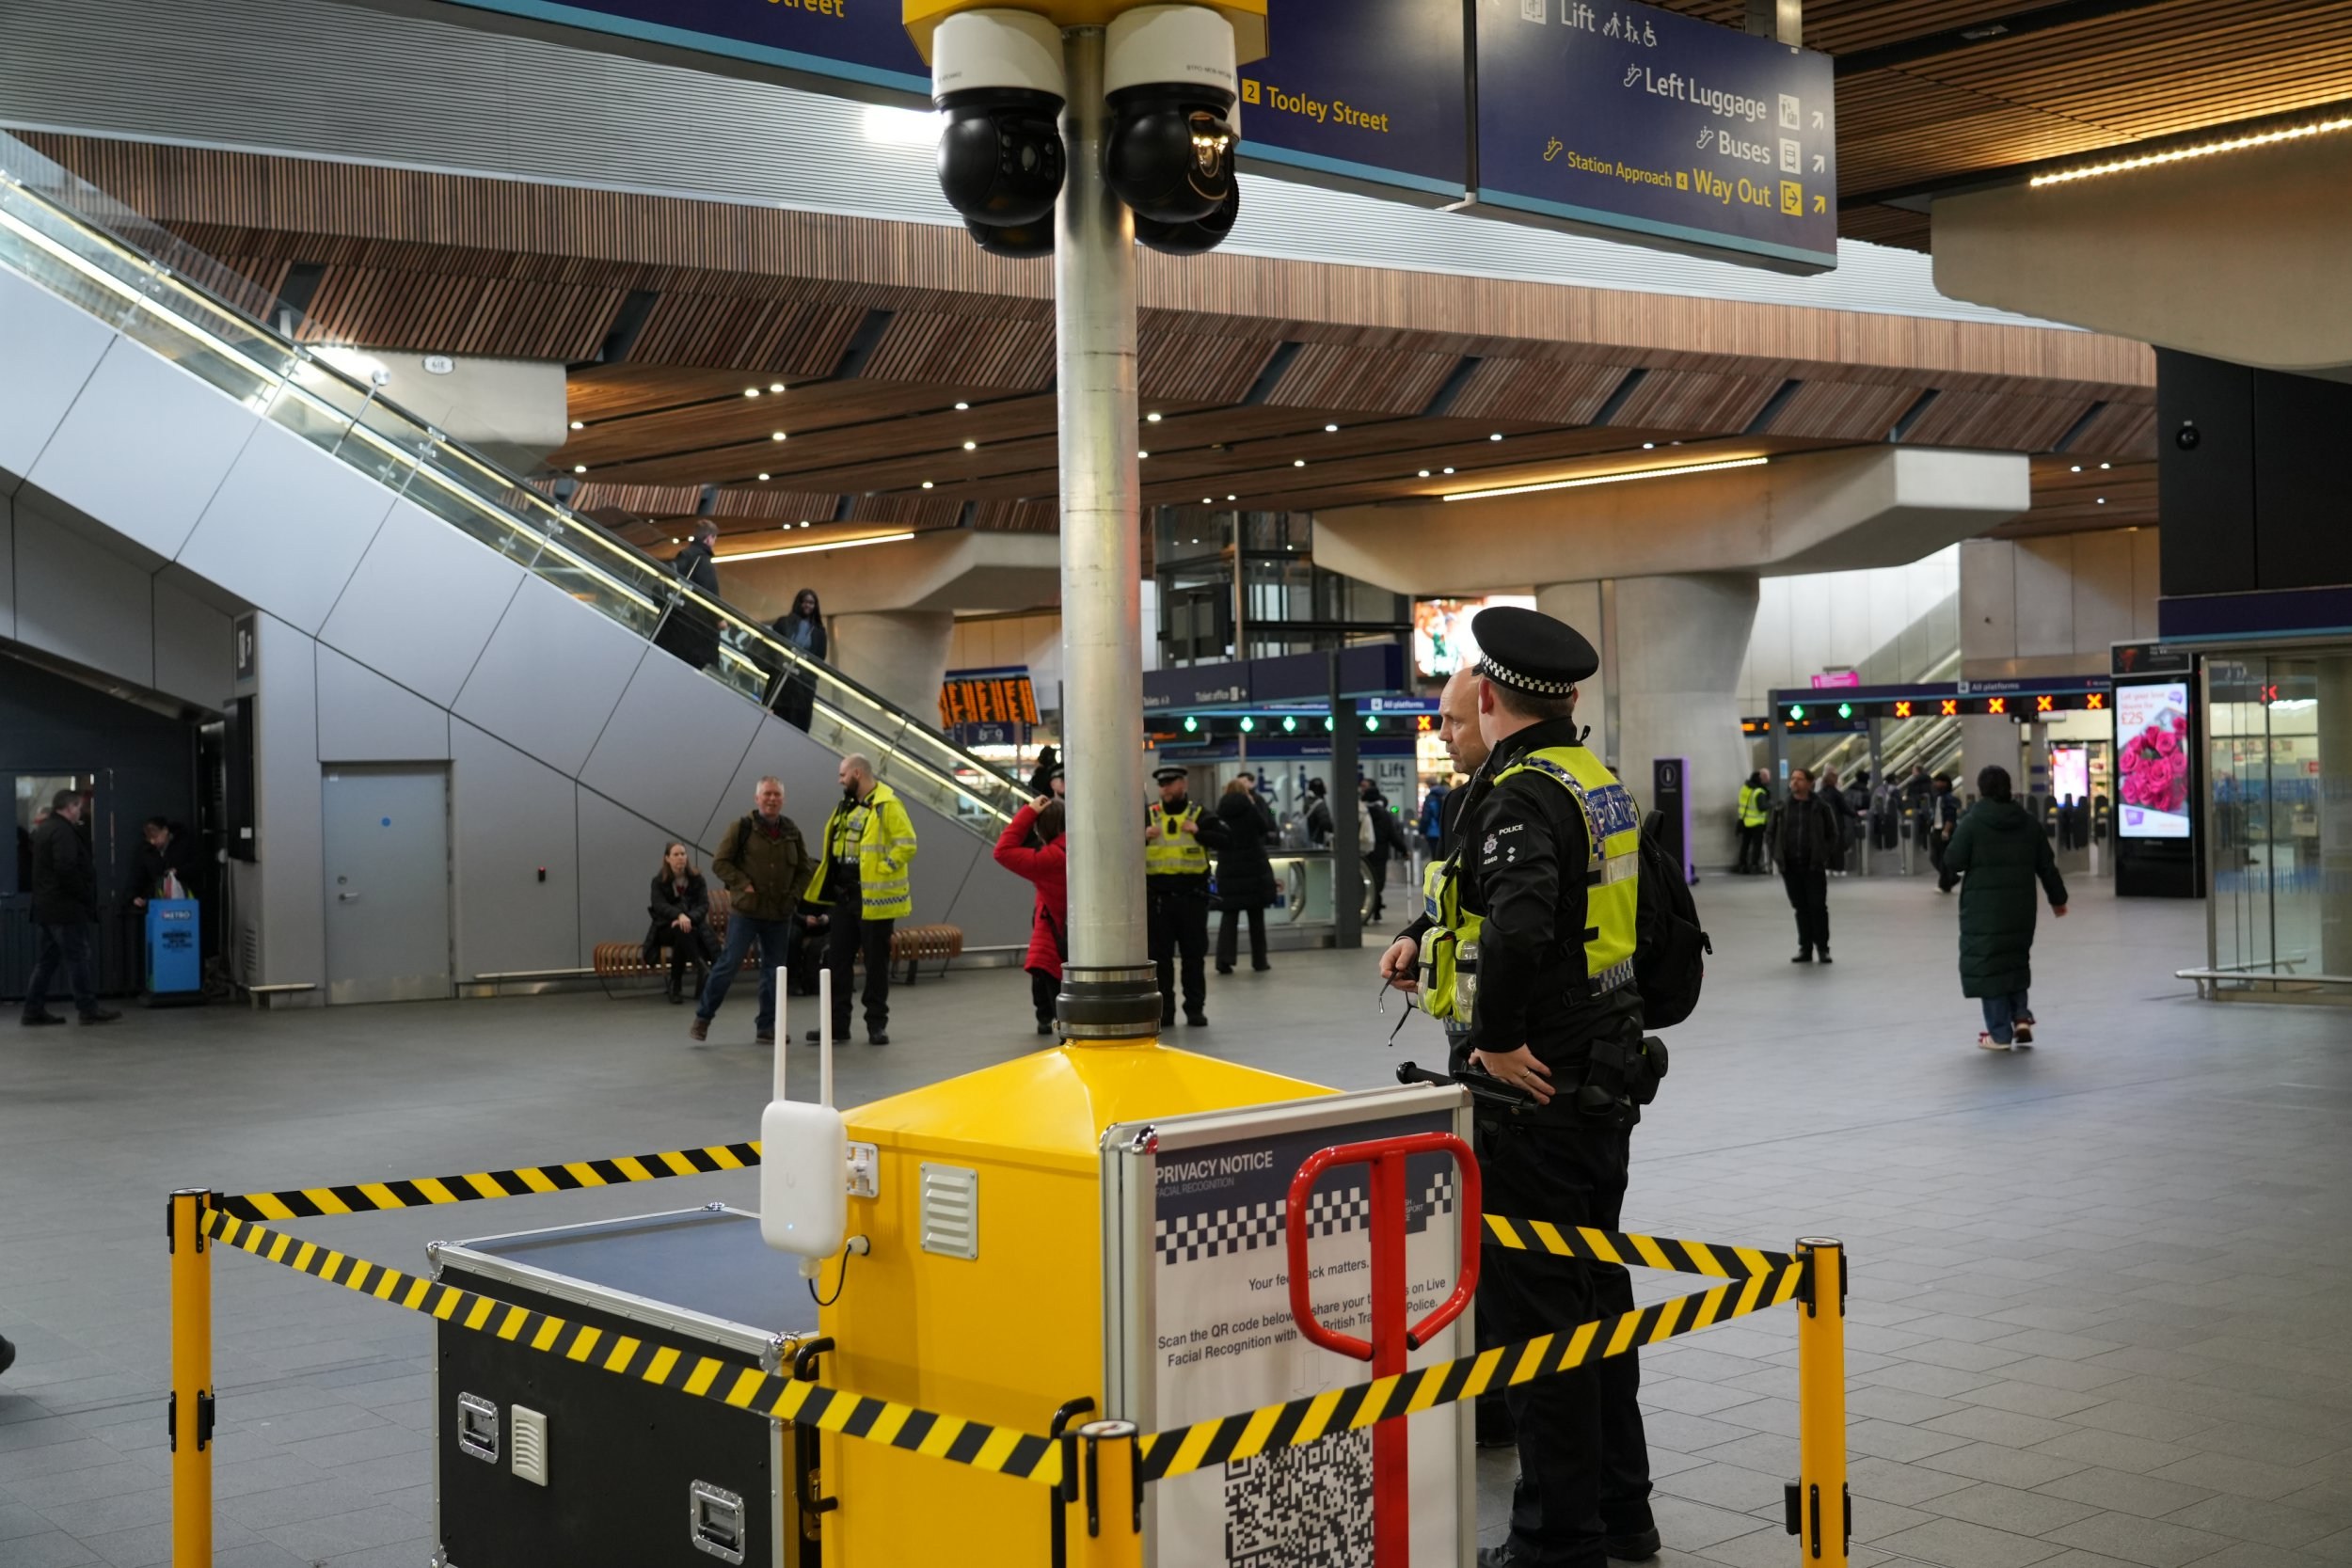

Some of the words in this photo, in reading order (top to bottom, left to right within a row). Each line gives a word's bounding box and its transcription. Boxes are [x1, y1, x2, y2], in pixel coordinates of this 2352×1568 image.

[1561, 0, 1596, 32] Lift
[1247, 85, 1256, 99] 2
[1266, 86, 1328, 123] Tooley
[1332, 101, 1390, 133] Street
[1645, 67, 1685, 101] Left
[1689, 78, 1767, 122] Luggage
[1718, 130, 1772, 165] Buses
[1567, 151, 1613, 175] Station
[1615, 162, 1672, 187] Approach
[1692, 168, 1733, 205] Way
[1738, 178, 1772, 207] Out
[1384, 700, 1392, 708] All
[1393, 700, 1425, 709] platforms
[2122, 712, 2143, 725] £25
[1380, 763, 1406, 778] Lift
[1498, 823, 1524, 835] POLICE
[1155, 1158, 1217, 1185] PRIVACY
[1220, 1150, 1274, 1175] NOTICE
[1156, 1186, 1181, 1197] FACIAL
[1183, 1177, 1234, 1194] RECOGNITION
[1248, 1277, 1274, 1291] Your
[1327, 1259, 1370, 1276] matters.
[1158, 1333, 1187, 1350] Scan
[1190, 1328, 1209, 1343] the
[1211, 1323, 1229, 1338] QR
[1232, 1318, 1260, 1334] code
[1263, 1311, 1295, 1327] below
[1311, 1300, 1340, 1316] share
[1343, 1296, 1365, 1313] your
[1411, 1283, 1424, 1294] on
[1426, 1277, 1446, 1291] Live
[1168, 1347, 1202, 1368] Facial
[1205, 1335, 1271, 1359] Recognition
[1274, 1327, 1298, 1343] with
[1322, 1312, 1356, 1331] British
[1406, 1297, 1438, 1314] Police.
